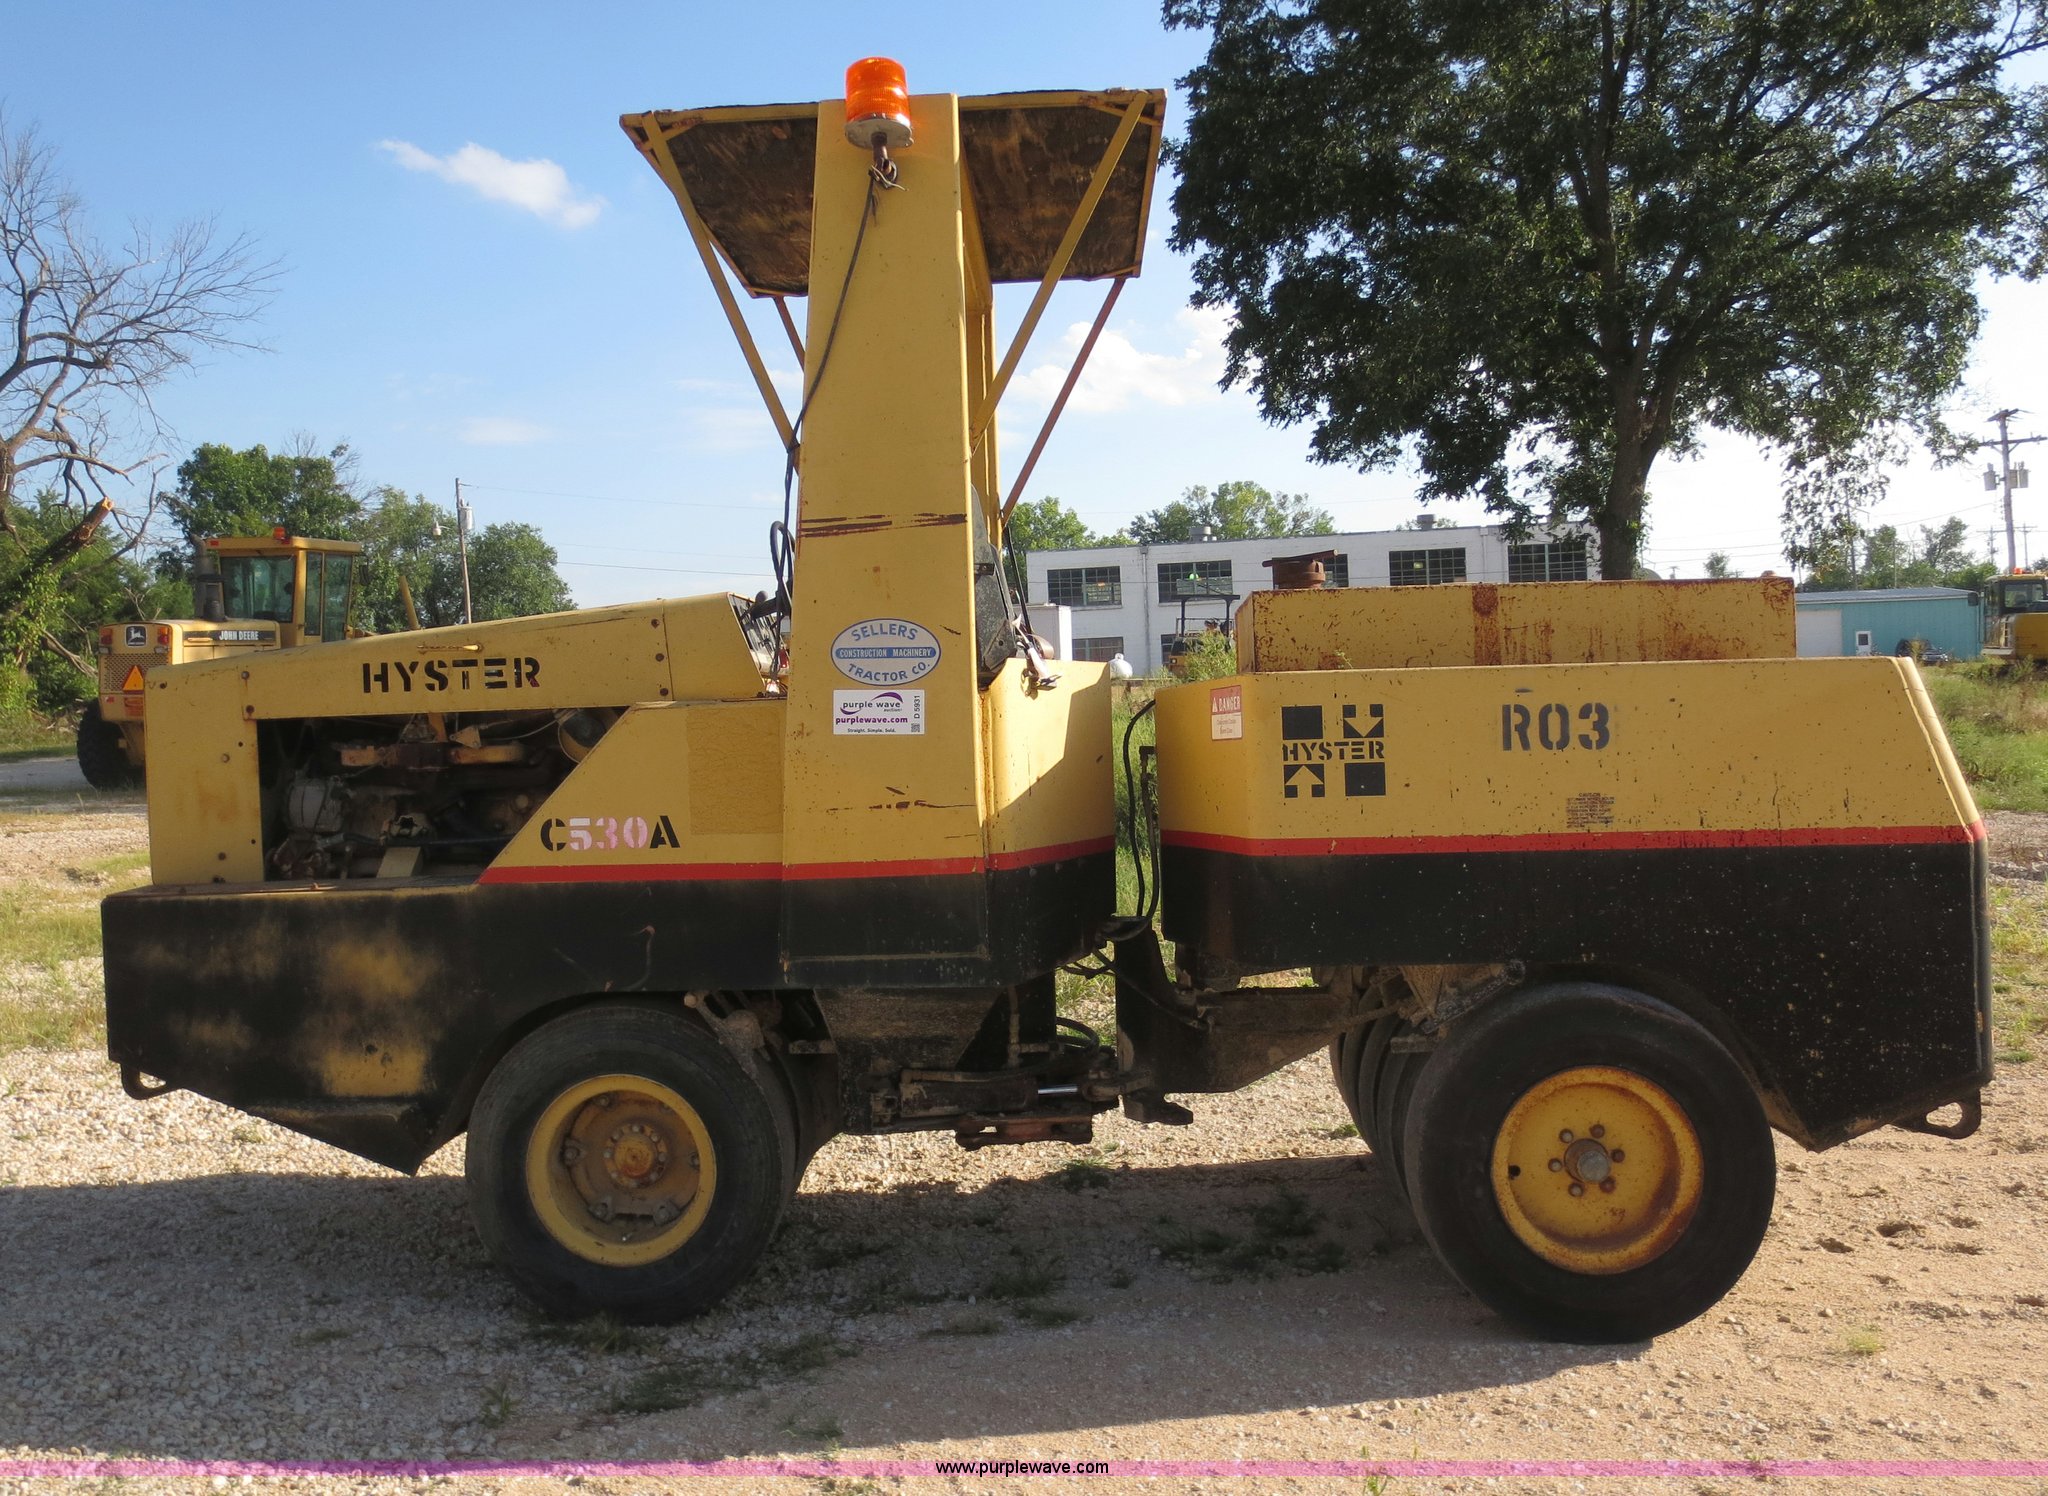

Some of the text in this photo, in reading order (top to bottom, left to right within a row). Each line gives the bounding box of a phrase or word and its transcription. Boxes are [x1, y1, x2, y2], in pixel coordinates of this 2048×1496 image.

[219, 630, 259, 640] JOHN DEERE
[851, 623, 919, 641] SELLERS
[839, 648, 932, 658] CONSTRUCTION MACHINERY
[362, 656, 541, 693] HYSTER
[848, 661, 931, 682] TRACTOR CO.
[842, 701, 873, 709] purple
[913, 695, 921, 712] 5931
[1218, 696, 1241, 712] DANGER
[835, 716, 908, 725] purplewave.com
[1282, 741, 1385, 761] HYSTER
[540, 815, 681, 851] C530A
